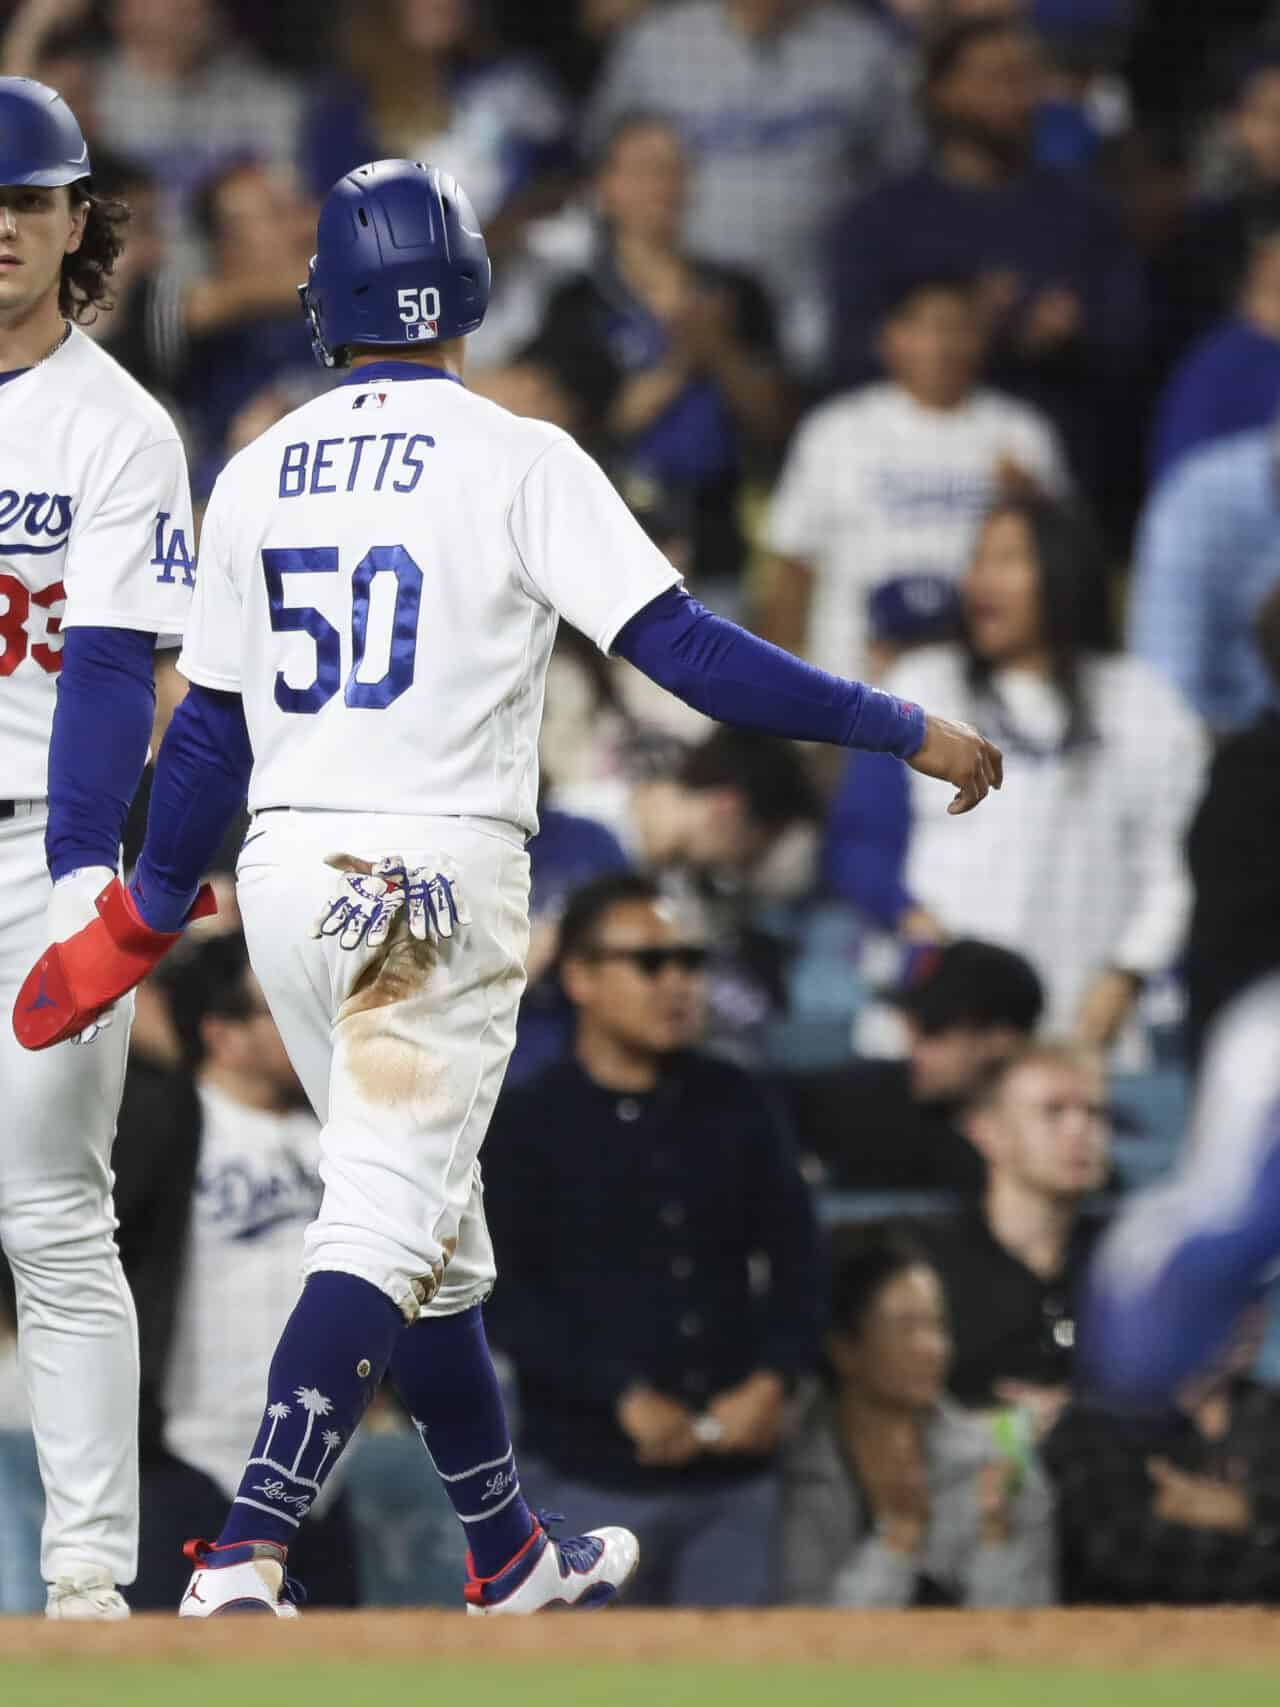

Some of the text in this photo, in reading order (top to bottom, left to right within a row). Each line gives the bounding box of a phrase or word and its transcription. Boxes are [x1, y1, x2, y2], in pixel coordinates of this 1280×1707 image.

[397, 287, 441, 323] 50
[278, 432, 436, 498] BETTS
[150, 512, 196, 587] LA
[261, 544, 425, 714] 50
[252, 1478, 287, 1500] Los
